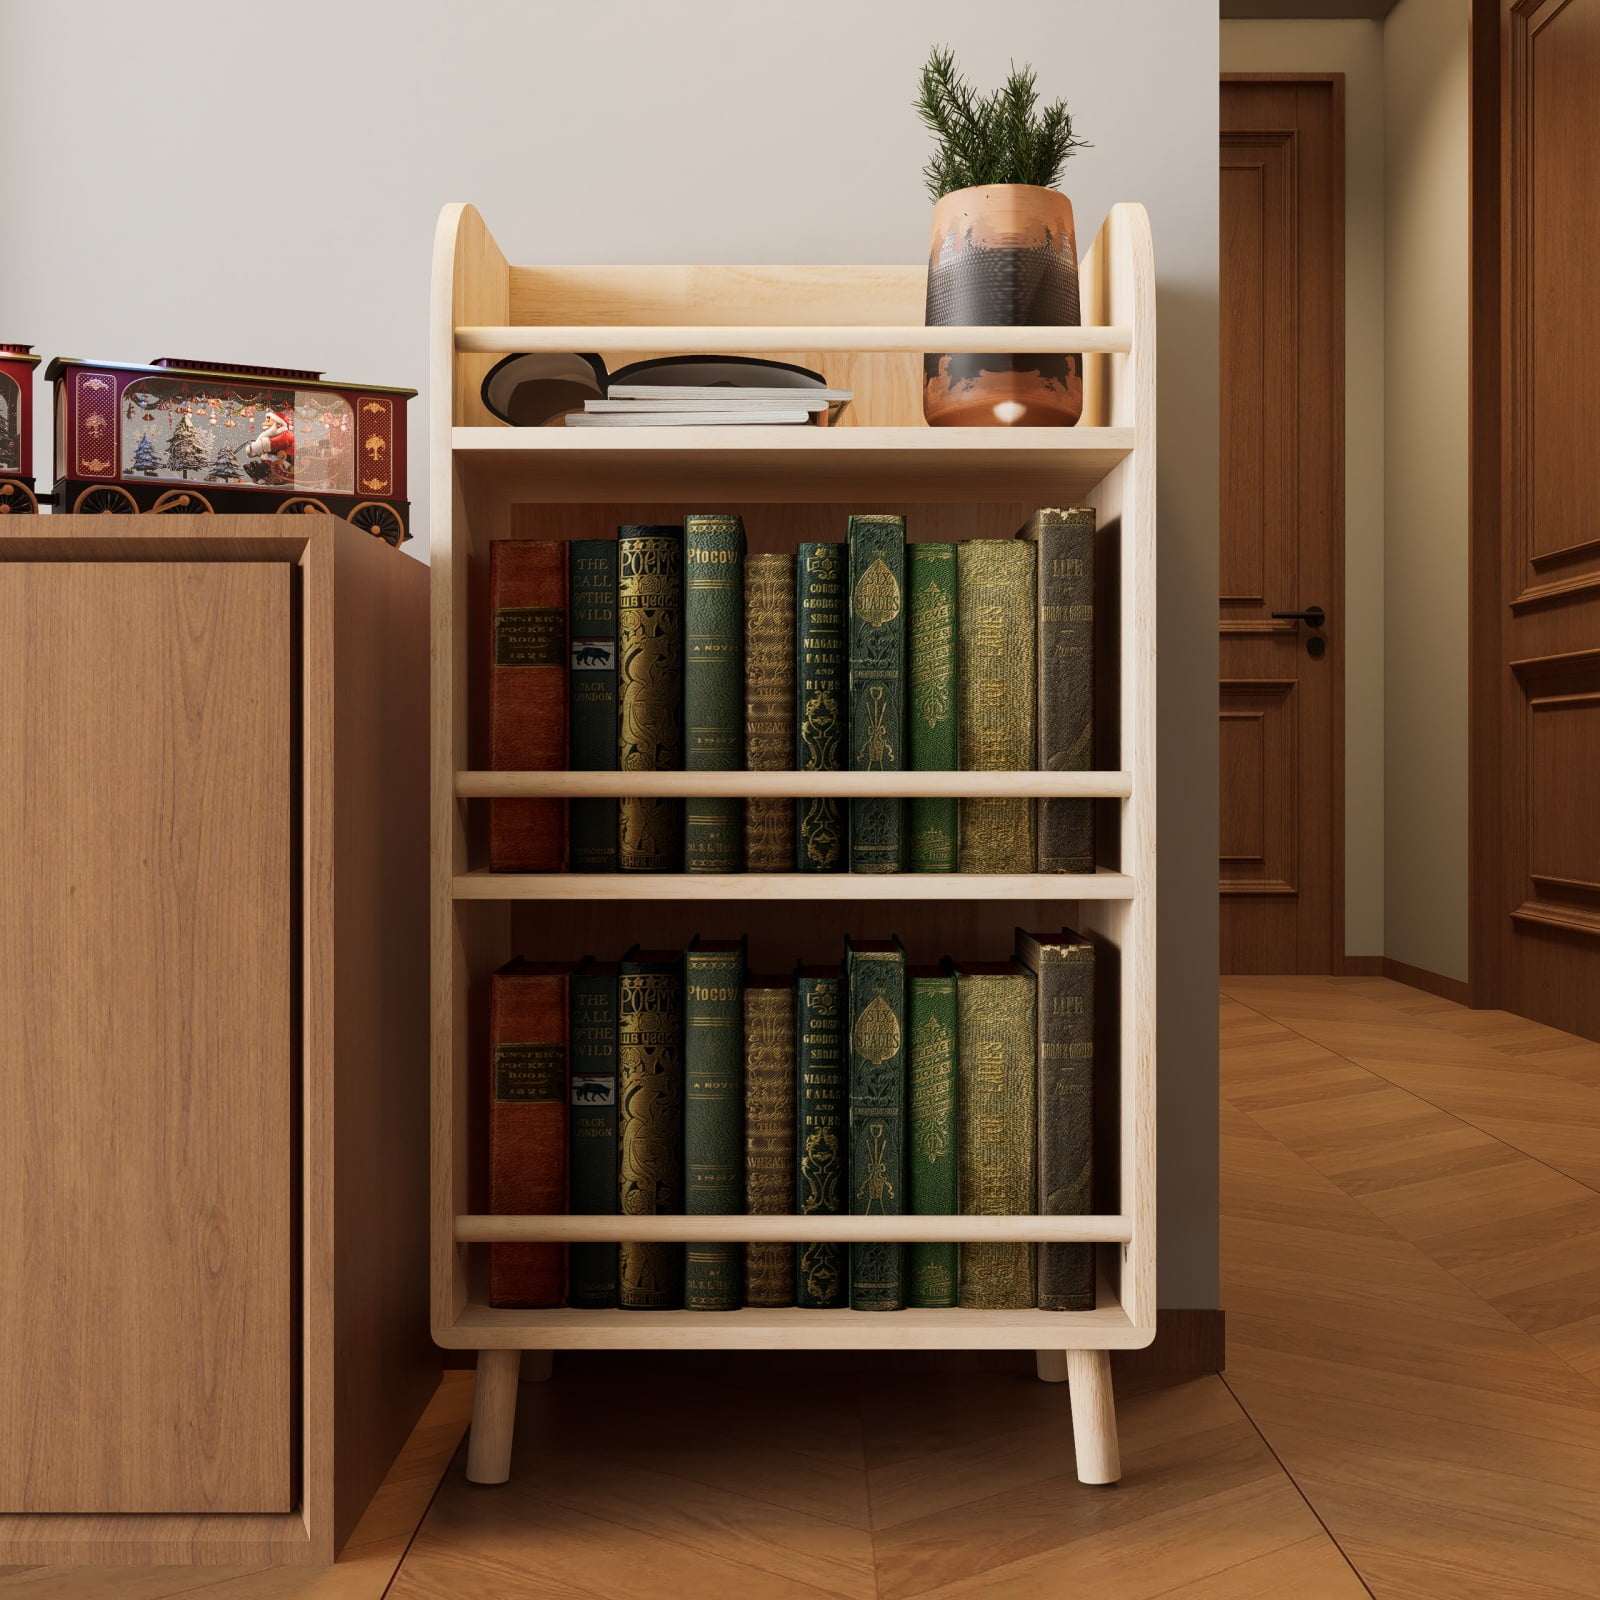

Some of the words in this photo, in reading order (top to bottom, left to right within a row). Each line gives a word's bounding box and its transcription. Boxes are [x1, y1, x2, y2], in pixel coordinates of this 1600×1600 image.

[577, 558, 609, 570] THE
[1053, 560, 1083, 576] LIFE
[573, 575, 614, 587] CALL
[866, 572, 893, 586] SIX
[585, 591, 614, 604] THE
[856, 595, 900, 612] SPADES
[574, 608, 614, 621] WILD
[509, 635, 548, 643] BOOK
[912, 628, 950, 645] DOGS
[577, 993, 609, 1006] THE
[573, 1010, 614, 1023] CALL
[866, 1009, 893, 1022] SIX
[584, 1026, 614, 1040] THE
[856, 1032, 900, 1049] SPADES
[574, 1044, 614, 1057] WILD
